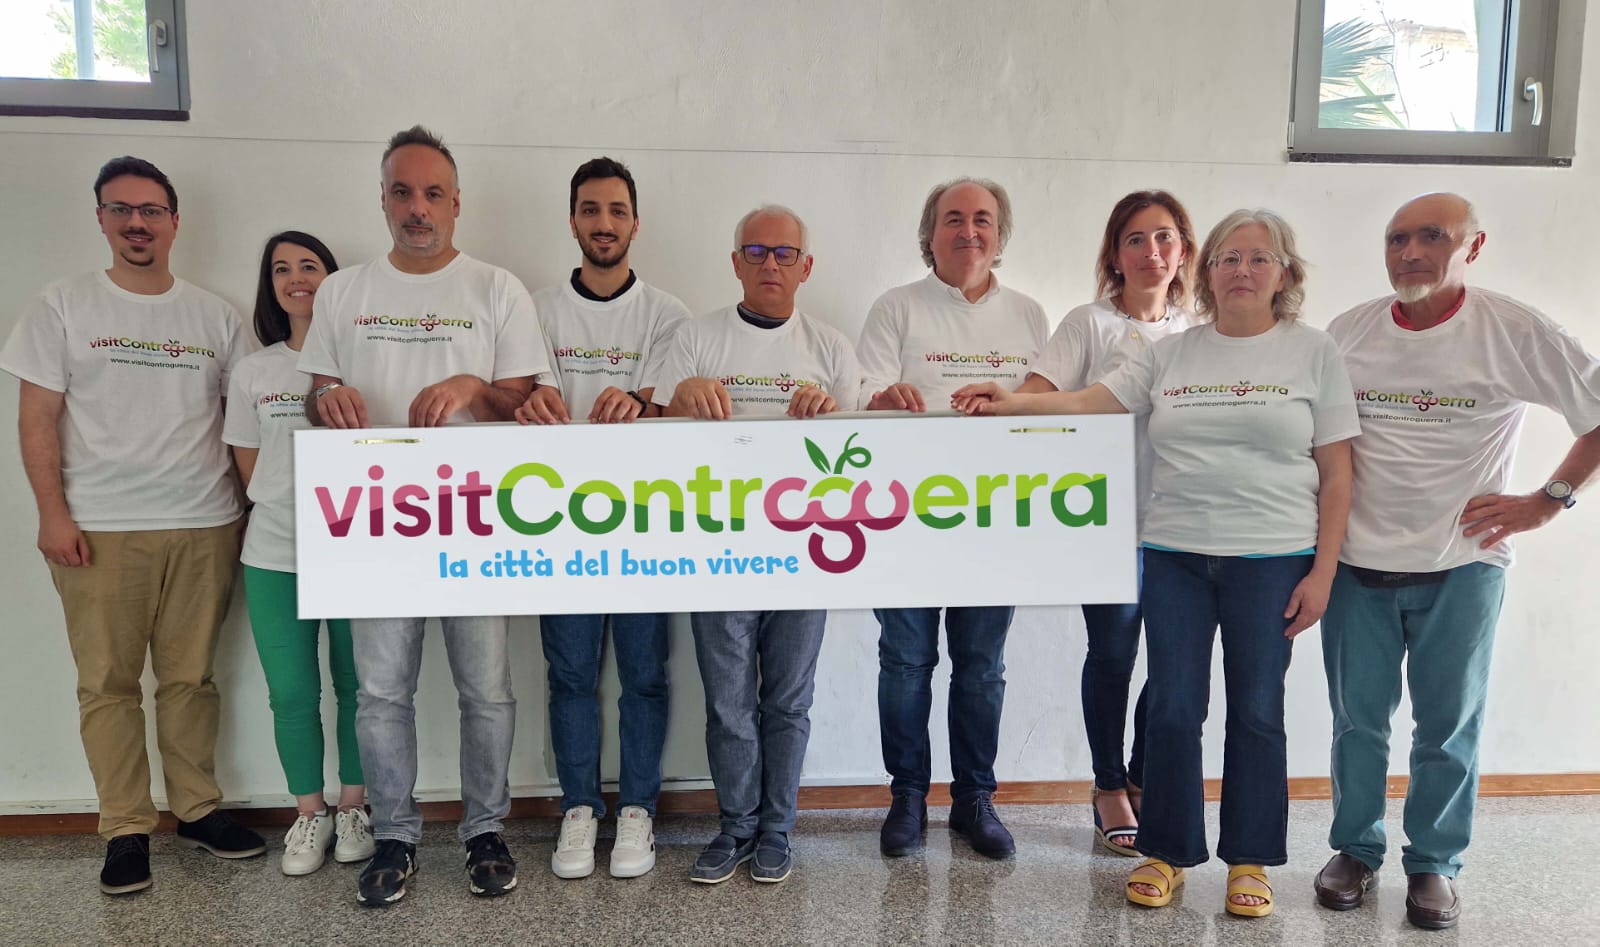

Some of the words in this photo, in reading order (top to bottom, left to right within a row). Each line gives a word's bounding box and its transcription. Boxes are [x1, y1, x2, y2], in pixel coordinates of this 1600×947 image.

[366, 334, 453, 344] www.visitcontroguerra.it
[110, 357, 200, 371] www.visitcontroguerra.it
[314, 462, 1108, 574] visitControguerra
[439, 551, 469, 579] la
[480, 548, 554, 578] città
[565, 549, 609, 577] del
[620, 549, 697, 577] buon
[706, 549, 799, 575] vivere
